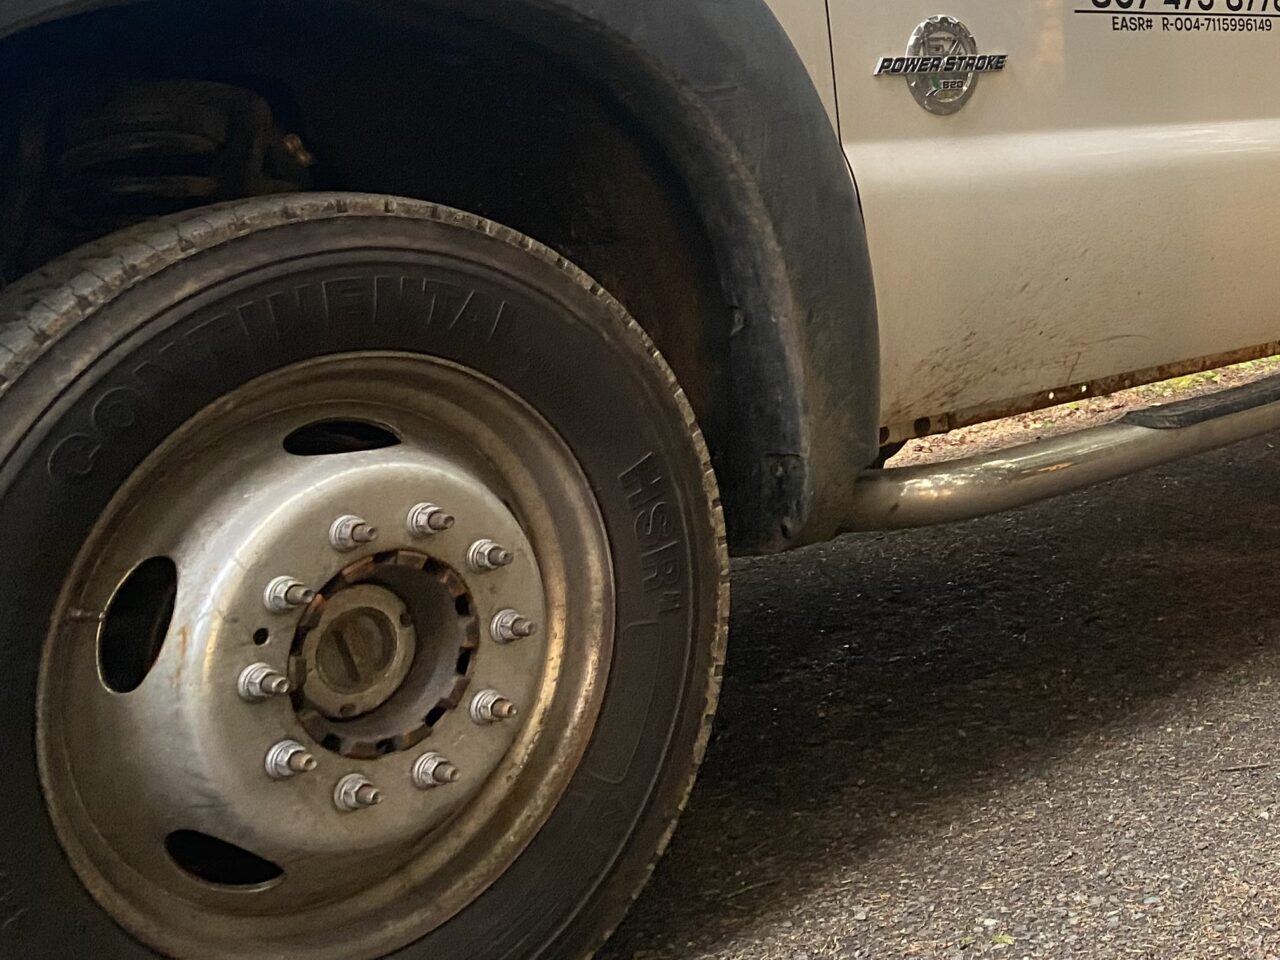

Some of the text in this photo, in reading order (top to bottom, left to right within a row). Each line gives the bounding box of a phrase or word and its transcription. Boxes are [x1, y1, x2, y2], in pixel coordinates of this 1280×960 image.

[1111, 16, 1153, 31] EASR#
[876, 54, 1008, 75] POWER STROKE
